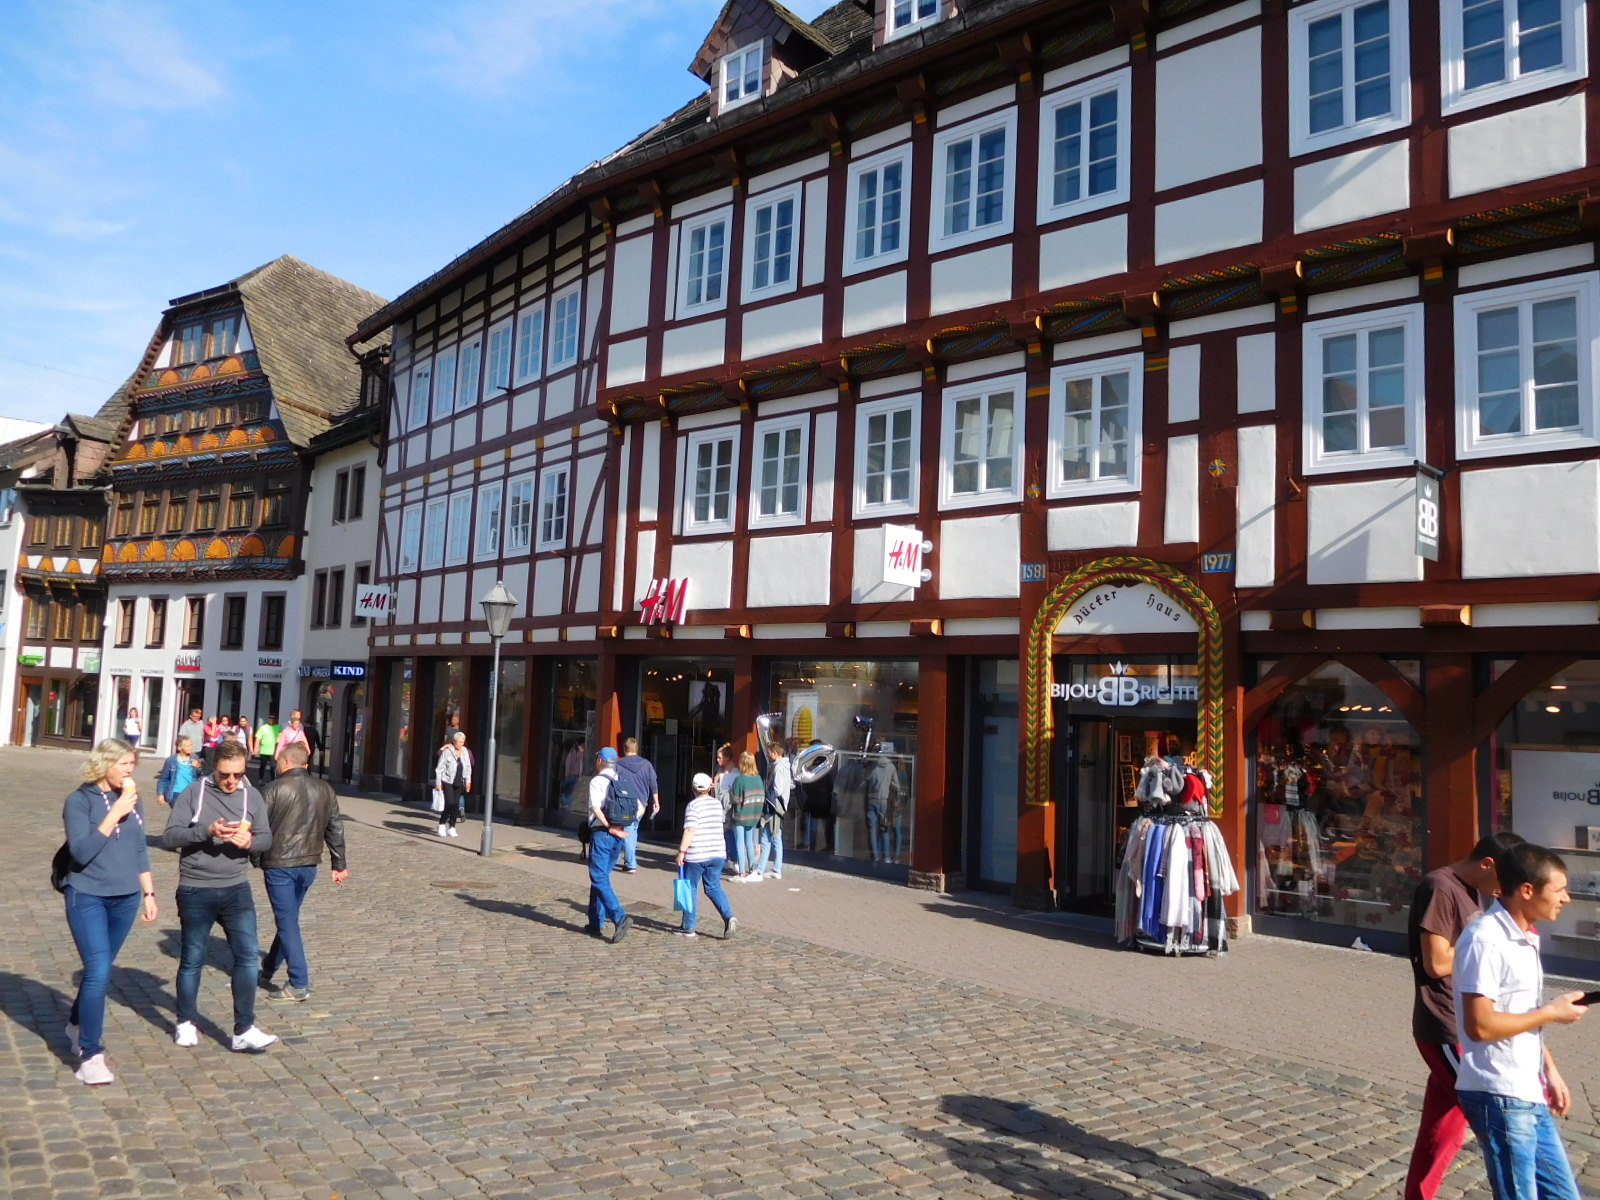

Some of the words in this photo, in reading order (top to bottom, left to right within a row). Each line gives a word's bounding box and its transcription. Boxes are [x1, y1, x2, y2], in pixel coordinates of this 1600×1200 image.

[889, 540, 919, 573] H&M
[1203, 554, 1232, 570] 1977
[1022, 564, 1046, 579] 1581
[360, 592, 387, 610] H&M
[640, 577, 690, 625] H&M
[1146, 593, 1181, 622] Haus
[333, 666, 364, 676] KIND
[1051, 683, 1097, 701] BIJOU
[1553, 791, 1585, 801] BIJOU
